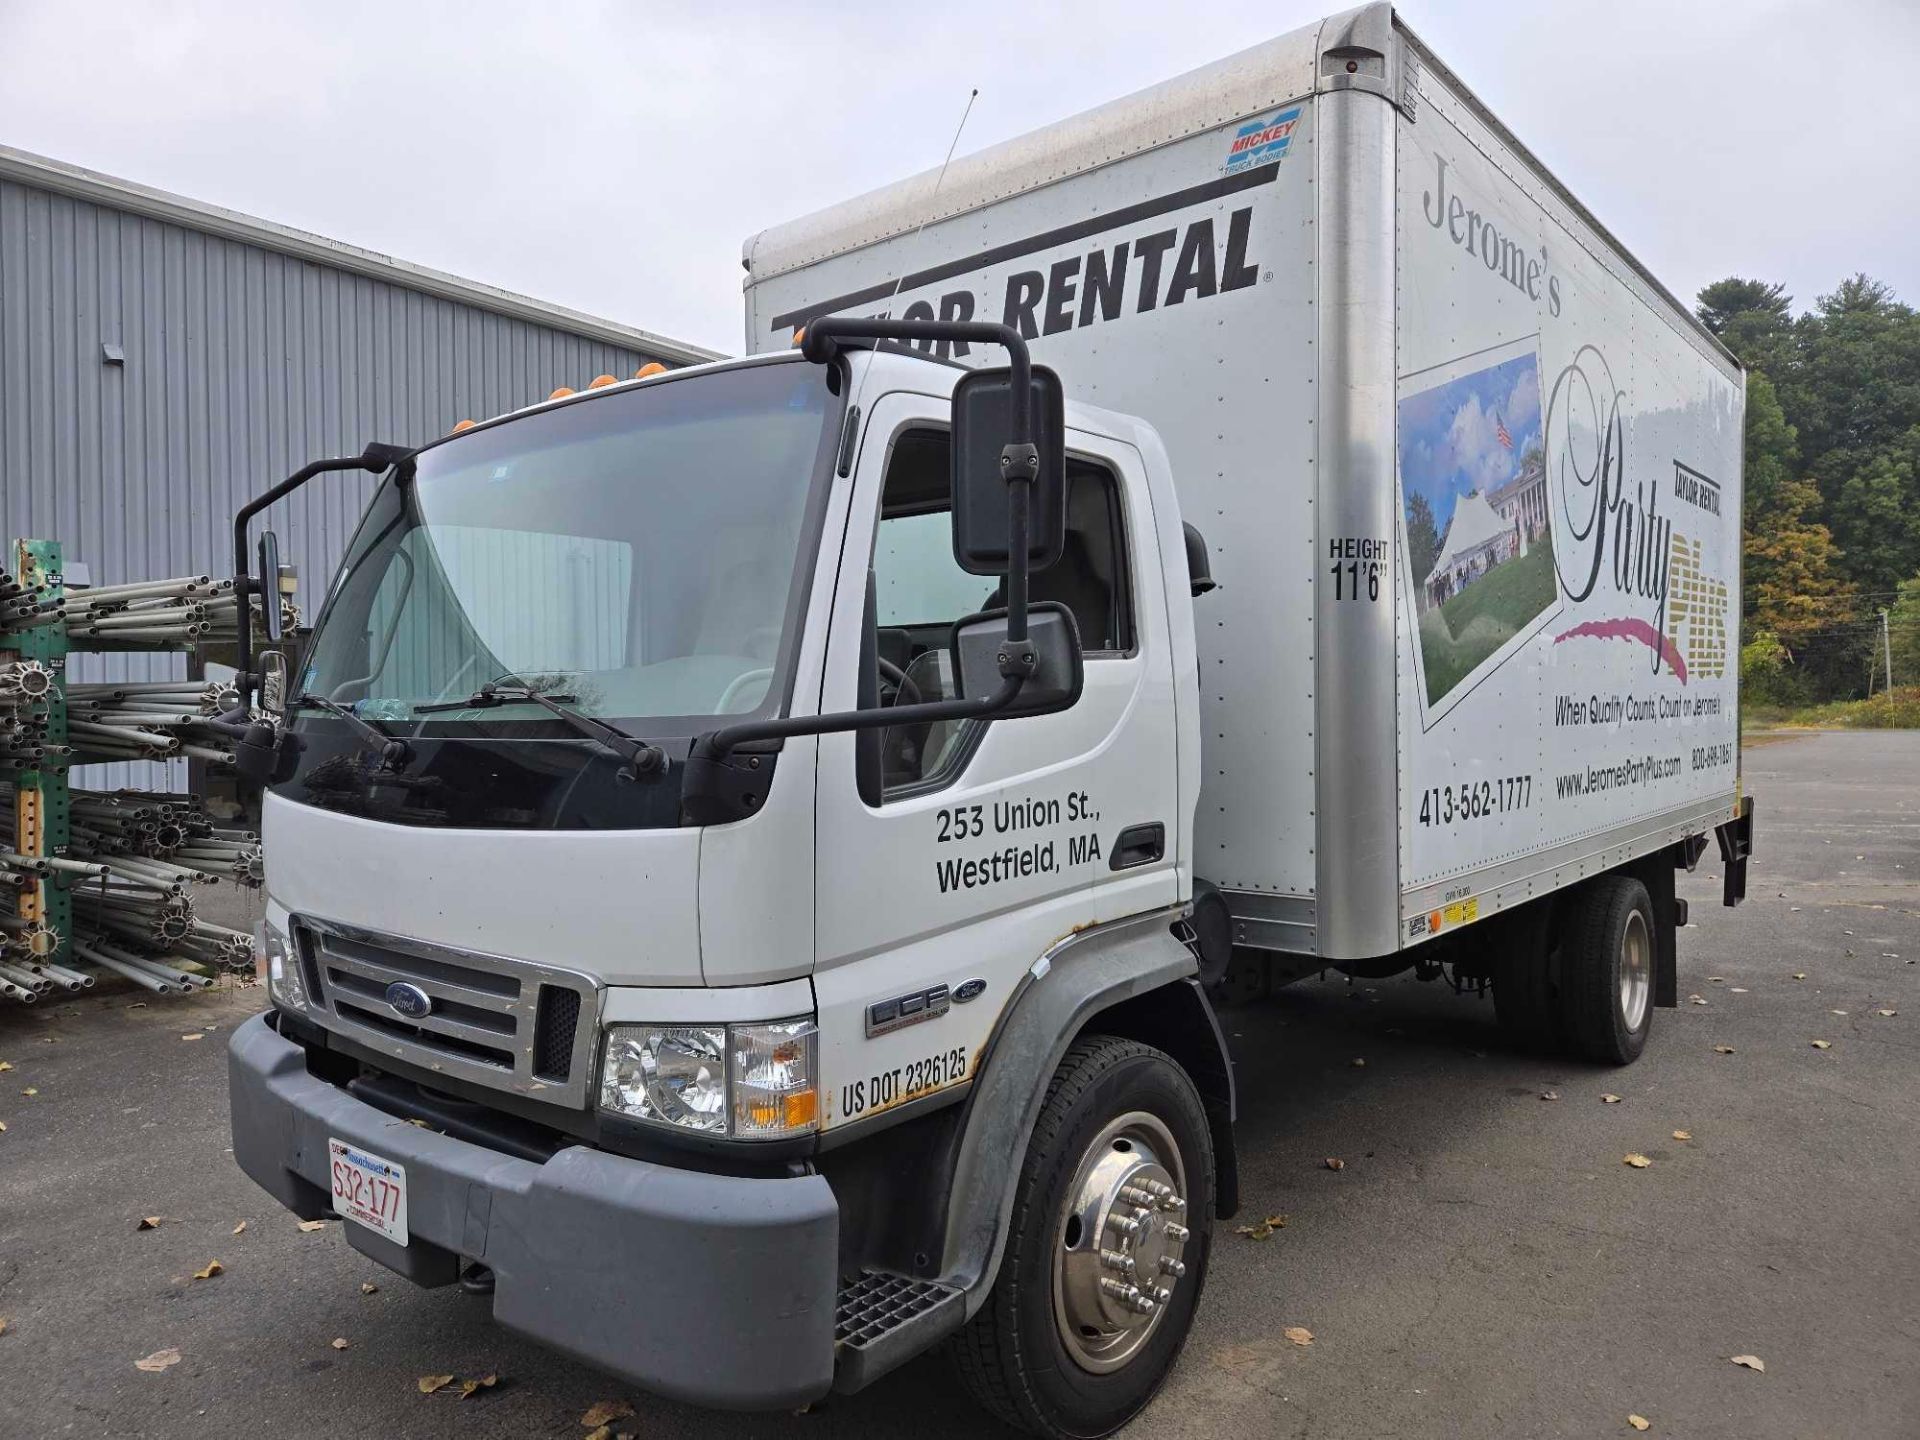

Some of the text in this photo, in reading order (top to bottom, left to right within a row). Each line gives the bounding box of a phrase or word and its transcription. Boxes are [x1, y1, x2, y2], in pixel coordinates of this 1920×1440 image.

[1231, 120, 1297, 153] MICKEY
[1223, 160, 1253, 175] TRUCK
[1423, 151, 1561, 318] Jerome's
[1002, 206, 1259, 341] RENTAL
[1545, 344, 1670, 676] Party
[1674, 462, 1698, 506] TAYLOR
[1330, 538, 1388, 560] HEIGHT
[1555, 695, 1587, 726] When
[1590, 695, 1624, 727] Quality
[1626, 695, 1657, 724] Counts,
[1660, 694, 1682, 719] Count
[1683, 699, 1692, 716] on
[1419, 776, 1532, 828] 413-562-1777
[1556, 755, 1681, 800] www.JeromesPartyPlus.com
[936, 790, 1100, 843] 253 Union St.,
[936, 833, 1101, 893] Westfield, MA
[843, 1046, 966, 1117] US DOT 2326125
